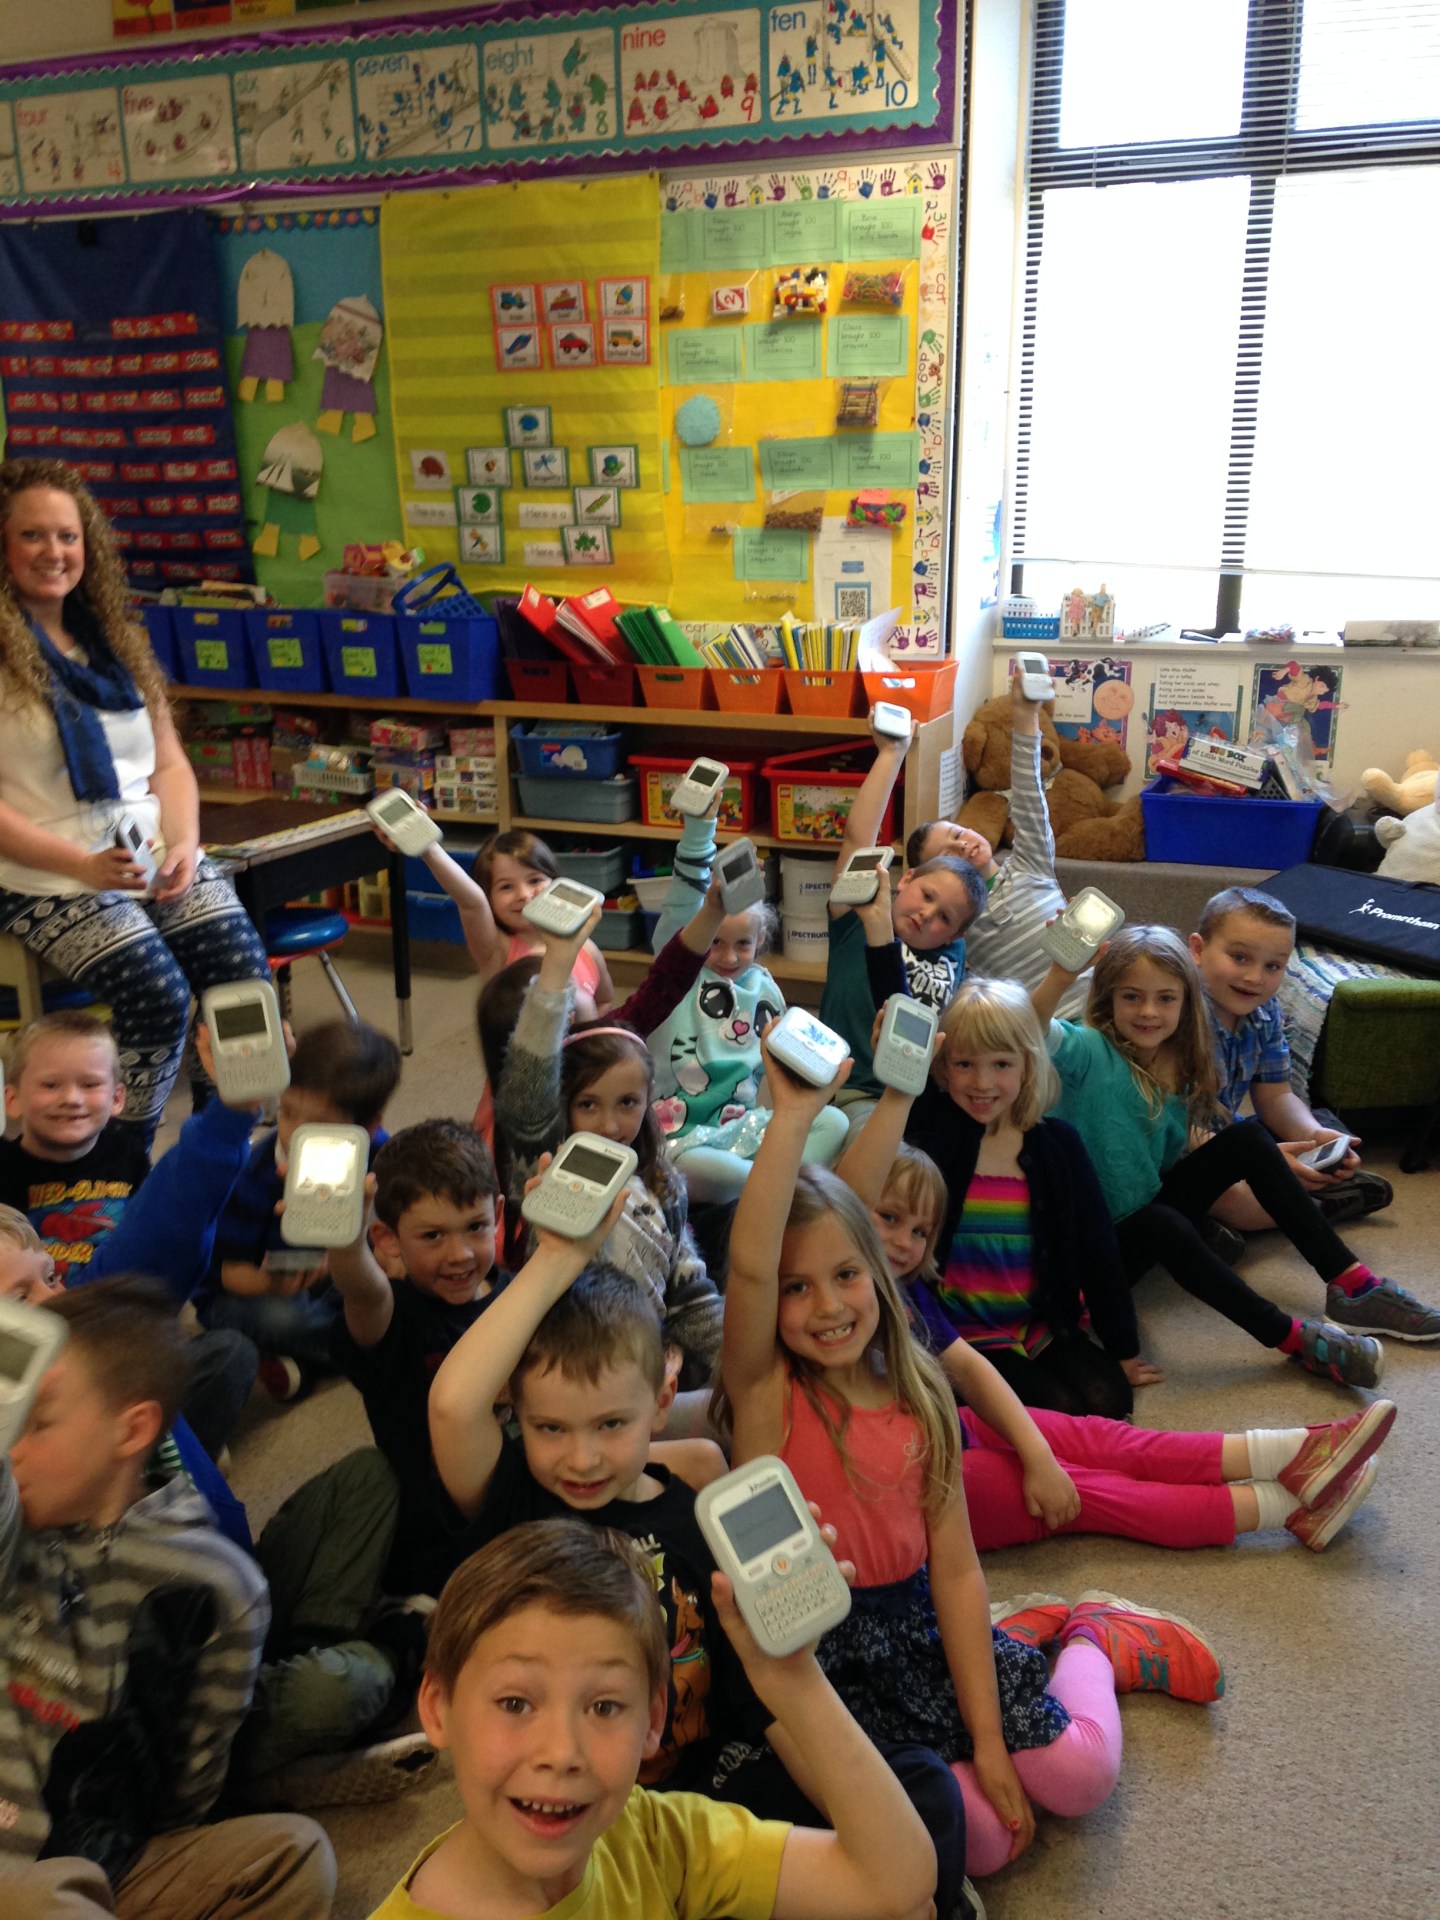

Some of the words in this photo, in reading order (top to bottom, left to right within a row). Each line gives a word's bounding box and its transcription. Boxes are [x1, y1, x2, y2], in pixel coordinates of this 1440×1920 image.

[771, 9, 806, 32] ten
[622, 27, 666, 50] nine
[359, 54, 410, 77] seven
[486, 40, 535, 74] eight
[122, 88, 154, 115] five
[884, 79, 908, 107] 10
[740, 95, 755, 121] 9
[596, 110, 609, 136] 8
[335, 135, 348, 159] 6
[463, 124, 475, 148] 7
[108, 160, 122, 179] 4
[837, 169, 848, 181] a
[848, 177, 857, 191] b
[935, 272, 947, 304] cat
[918, 352, 930, 383] dog
[685, 622, 708, 633] cat
[1200, 749, 1217, 761] Little
[1218, 756, 1235, 766] Word
[1235, 760, 1260, 774] Puzzles
[1210, 745, 1227, 757] BIG
[1227, 750, 1248, 763] BOX
[805, 882, 831, 890] SPECTR
[1368, 907, 1440, 930] Promethean
